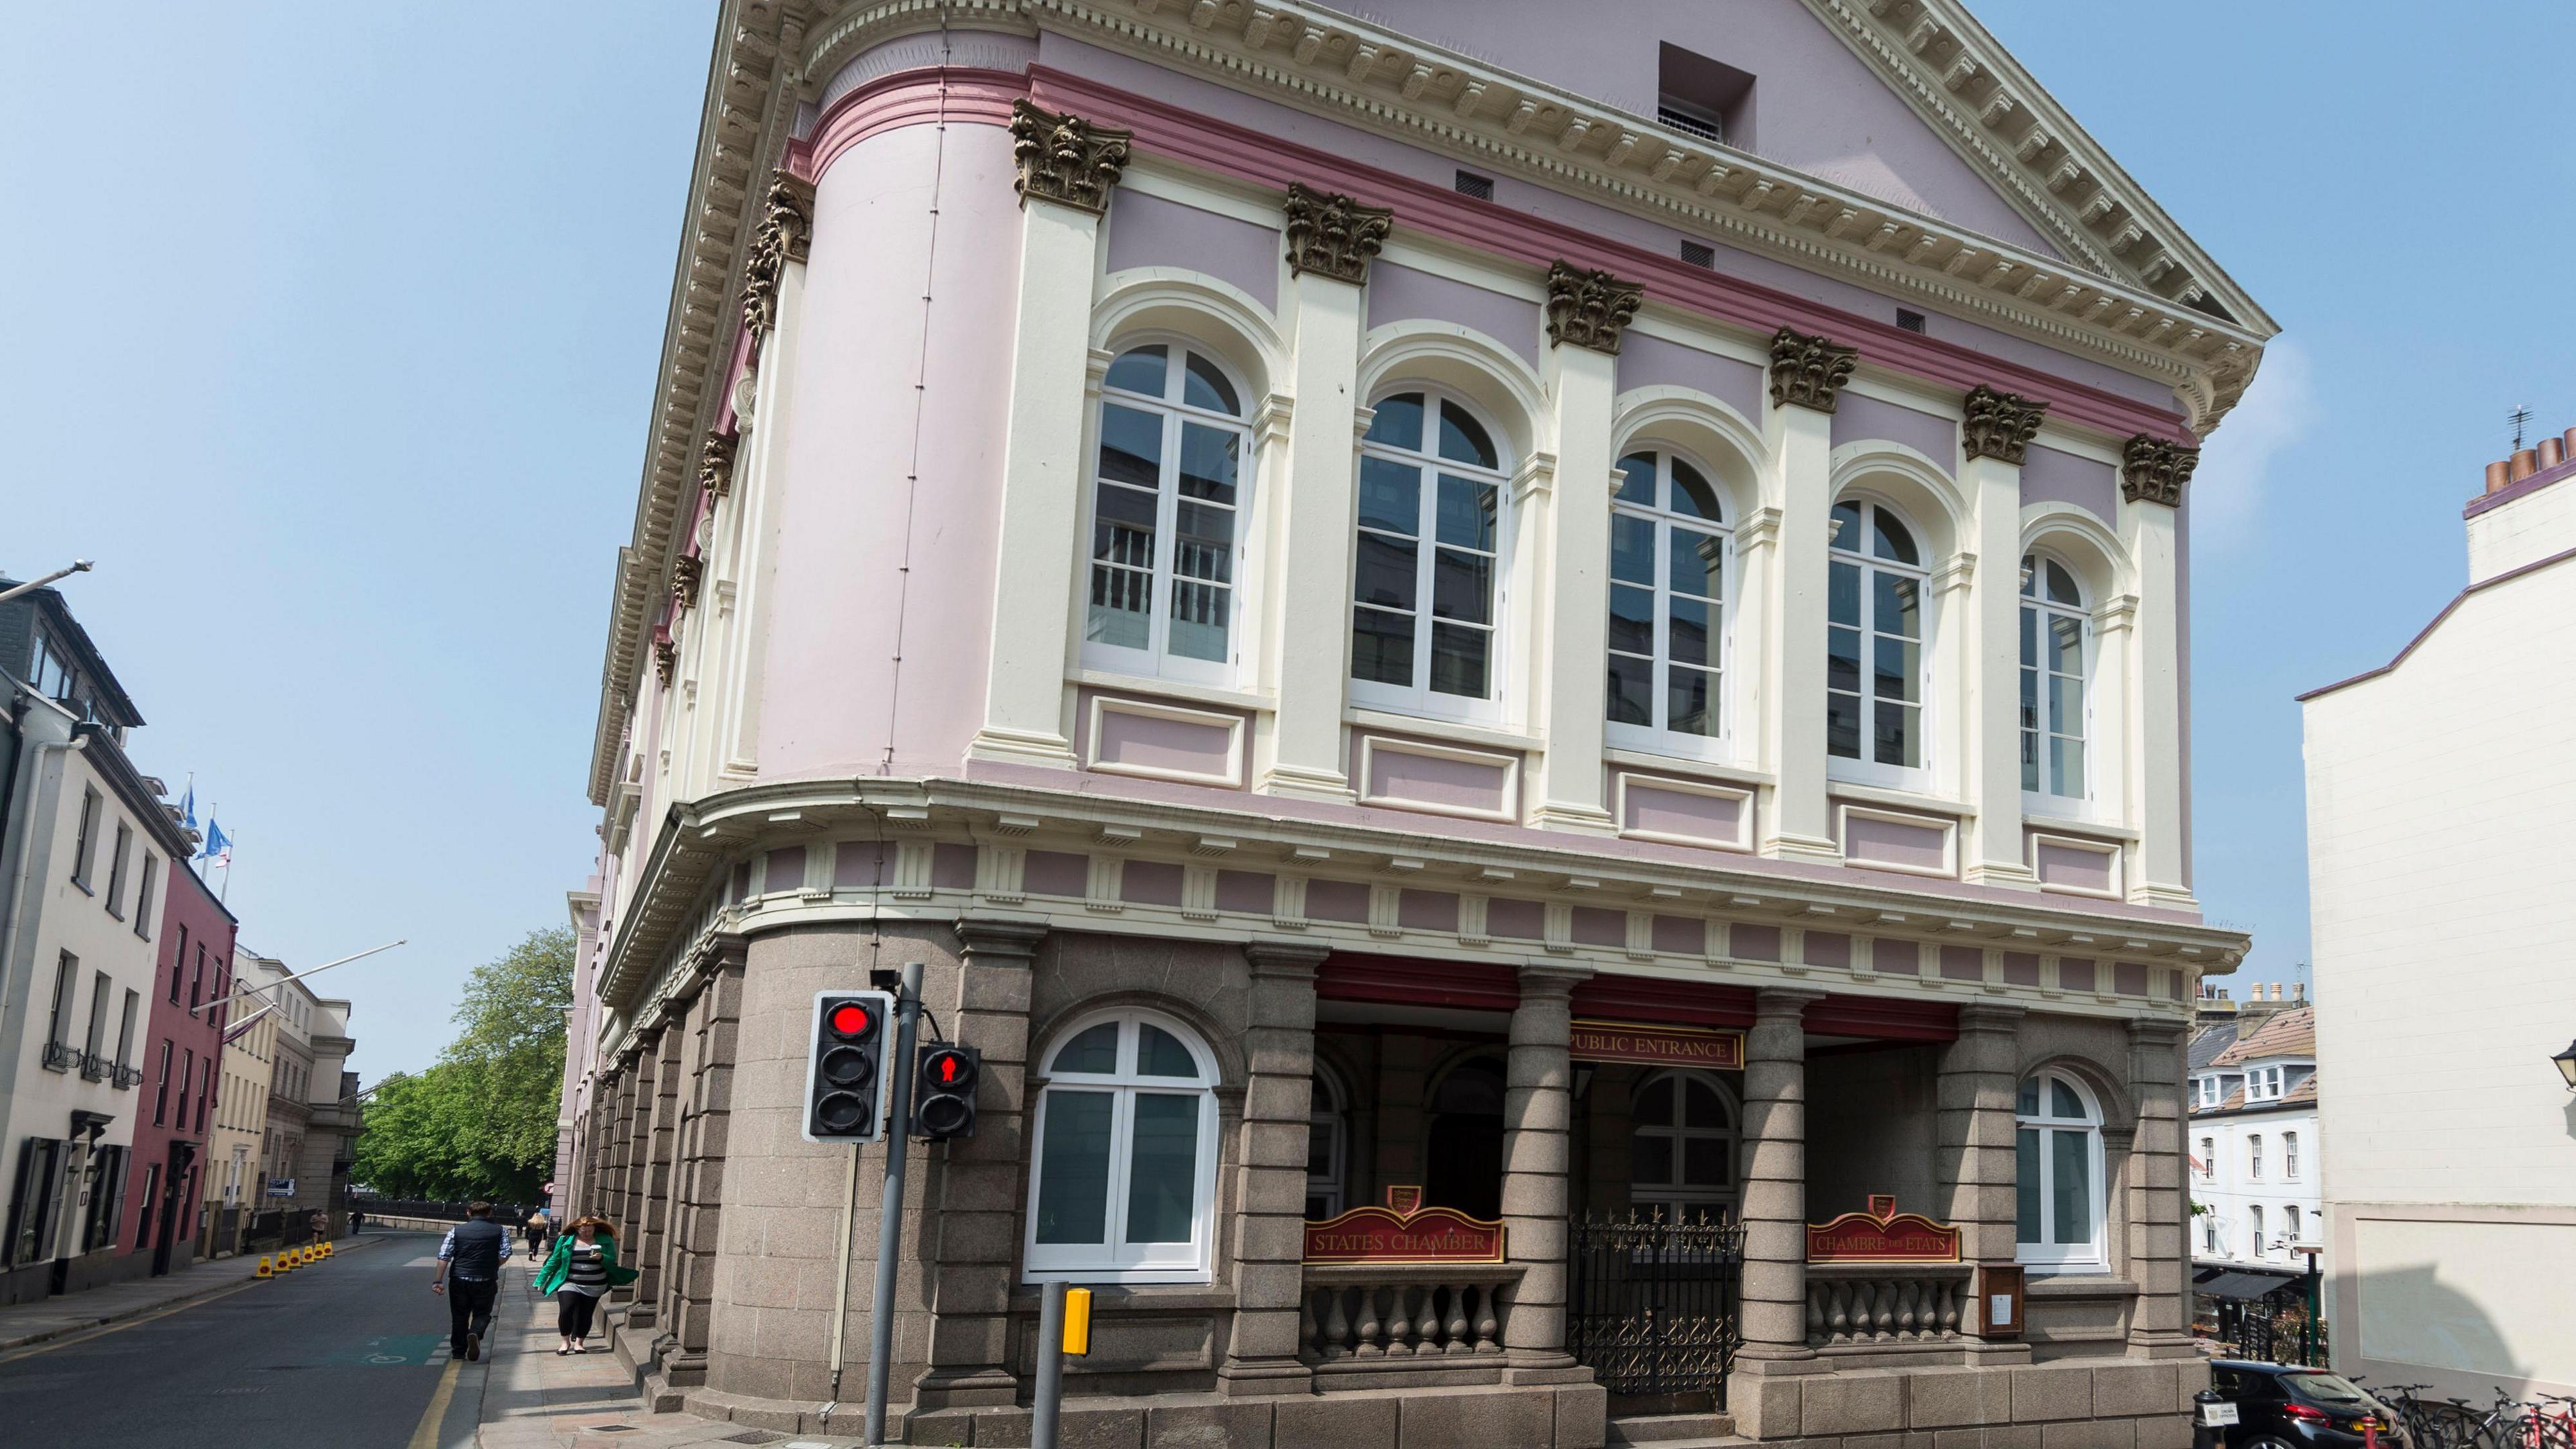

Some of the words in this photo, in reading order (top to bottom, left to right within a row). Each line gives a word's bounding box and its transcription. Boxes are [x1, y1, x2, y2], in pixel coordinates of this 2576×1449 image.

[1635, 1038, 1727, 1057] ENTRANCE
[1315, 1234, 1384, 1250] STATES
[1391, 1234, 1485, 1250] CHAMBER
[1816, 1236, 1886, 1251] CHAMBRE
[1905, 1236, 1945, 1251] ETATS
